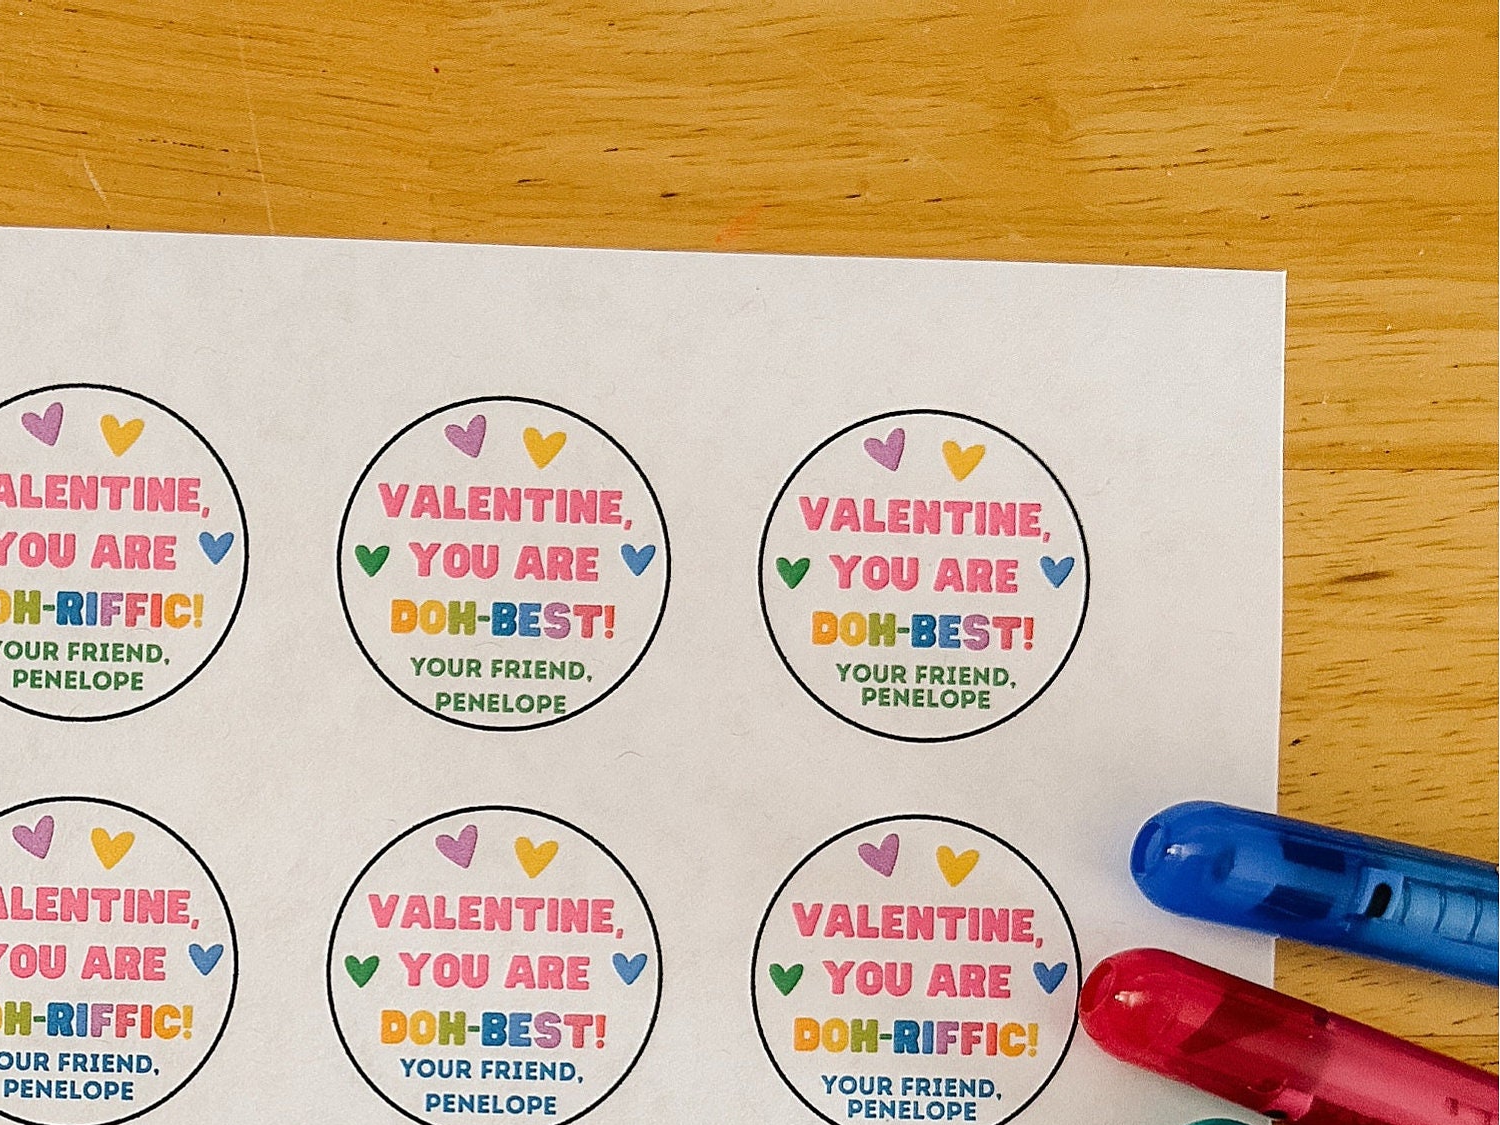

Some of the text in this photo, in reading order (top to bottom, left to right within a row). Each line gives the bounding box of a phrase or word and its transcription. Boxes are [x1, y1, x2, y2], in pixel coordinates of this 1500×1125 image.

[378, 483, 632, 531] VALENTINE,
[799, 496, 1051, 543] VALENTINE,
[90, 534, 177, 571] ARE
[409, 542, 599, 582] YOU ARE
[829, 554, 1019, 594] YOU ARE
[390, 599, 615, 639] DOH-BEST!
[812, 611, 1035, 651] DOH-BEST!
[67, 642, 170, 665] FRIEND,
[410, 657, 592, 682] YOUR FRIEND,
[13, 669, 143, 691] PENELOPE
[836, 663, 1016, 689] YOUR FRIEND,
[435, 692, 567, 714] PENELOPE
[862, 687, 991, 710] PENELOPE
[368, 894, 624, 939] VALENTINE,
[792, 902, 1044, 949] VALENTINE,
[81, 946, 167, 981] ARE
[399, 952, 590, 991] YOU ARE
[823, 960, 1012, 999] YOU ARE
[380, 1010, 607, 1049] DOH-BEST!
[794, 1017, 1039, 1058] DOH-RIFFIC!
[58, 1052, 160, 1076] FRIEND,
[400, 1058, 583, 1084] YOUR FRIEND,
[3, 1079, 134, 1101] PENELOPE
[425, 1093, 557, 1116] PENELOPE
[821, 1075, 1002, 1100] YOUR FRIEND,
[848, 1099, 977, 1121] PENELOPE
